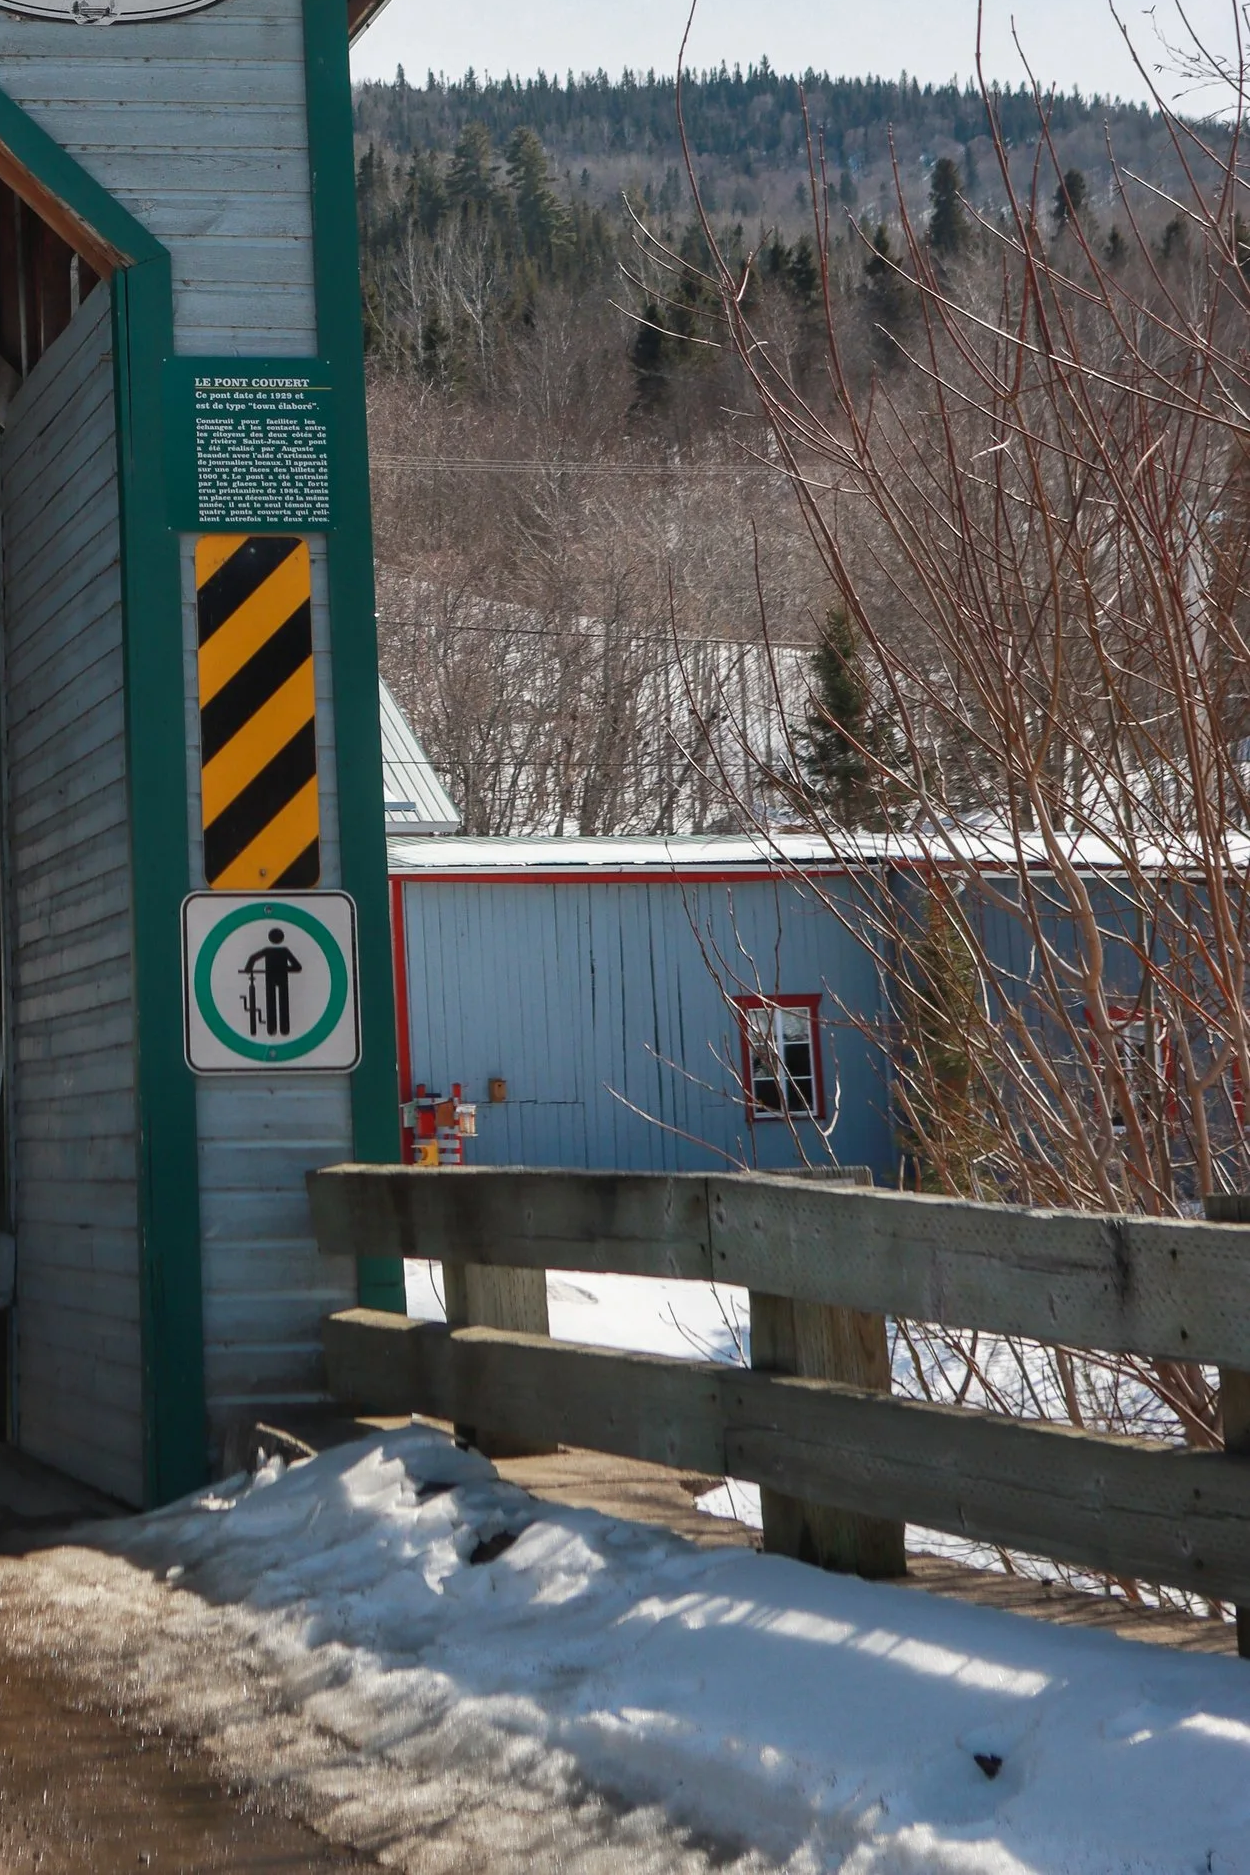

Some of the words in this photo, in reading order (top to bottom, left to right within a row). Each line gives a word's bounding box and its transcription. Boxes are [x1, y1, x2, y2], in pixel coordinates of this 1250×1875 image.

[195, 378, 211, 386] LE
[214, 378, 248, 387] PONT
[252, 379, 309, 387] COUVERT
[210, 392, 231, 400] pont
[226, 403, 245, 411] type
[278, 402, 319, 410] élaboré".
